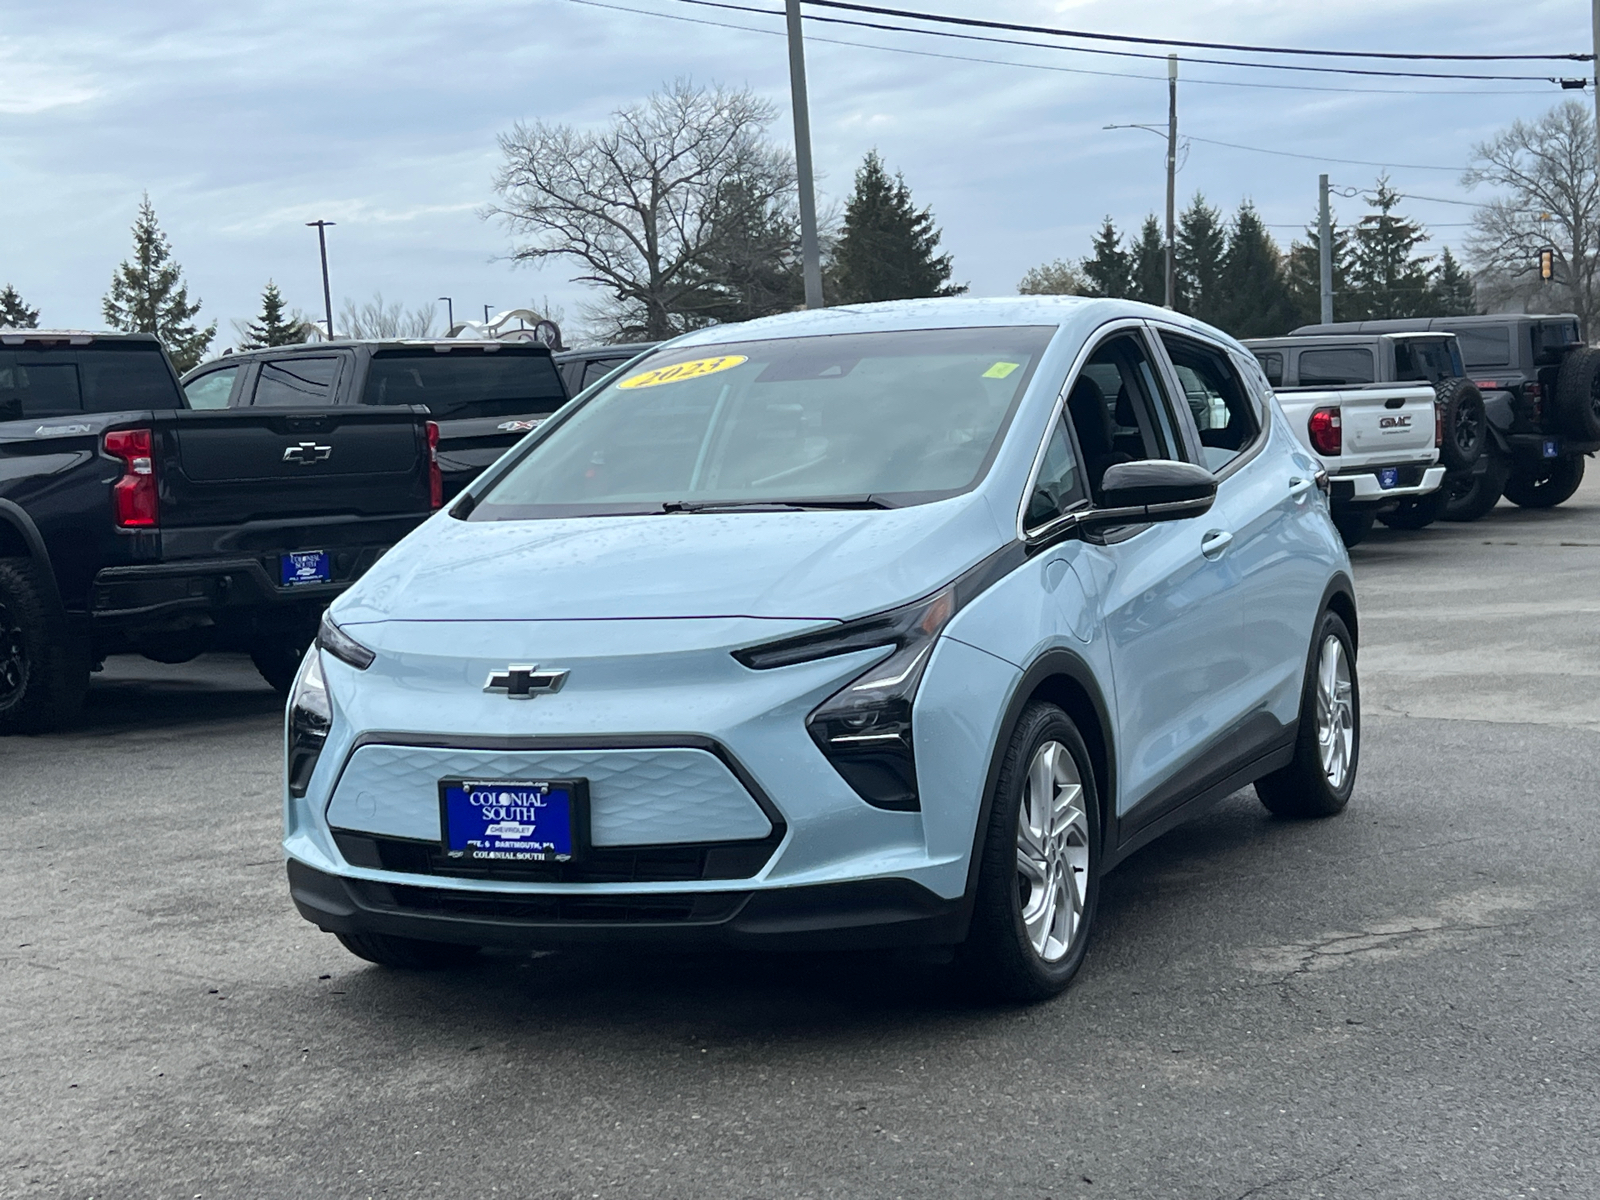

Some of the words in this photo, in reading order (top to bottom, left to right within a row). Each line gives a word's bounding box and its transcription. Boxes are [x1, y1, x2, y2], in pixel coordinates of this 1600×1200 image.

[634, 358, 727, 387] 2023
[1379, 416, 1412, 428] GMC
[469, 791, 548, 808] COLONIAL
[482, 807, 536, 822] SOUTH
[490, 826, 531, 834] CHEVROLET
[472, 850, 516, 860] COLONIAL
[516, 852, 545, 861] SOUTH
